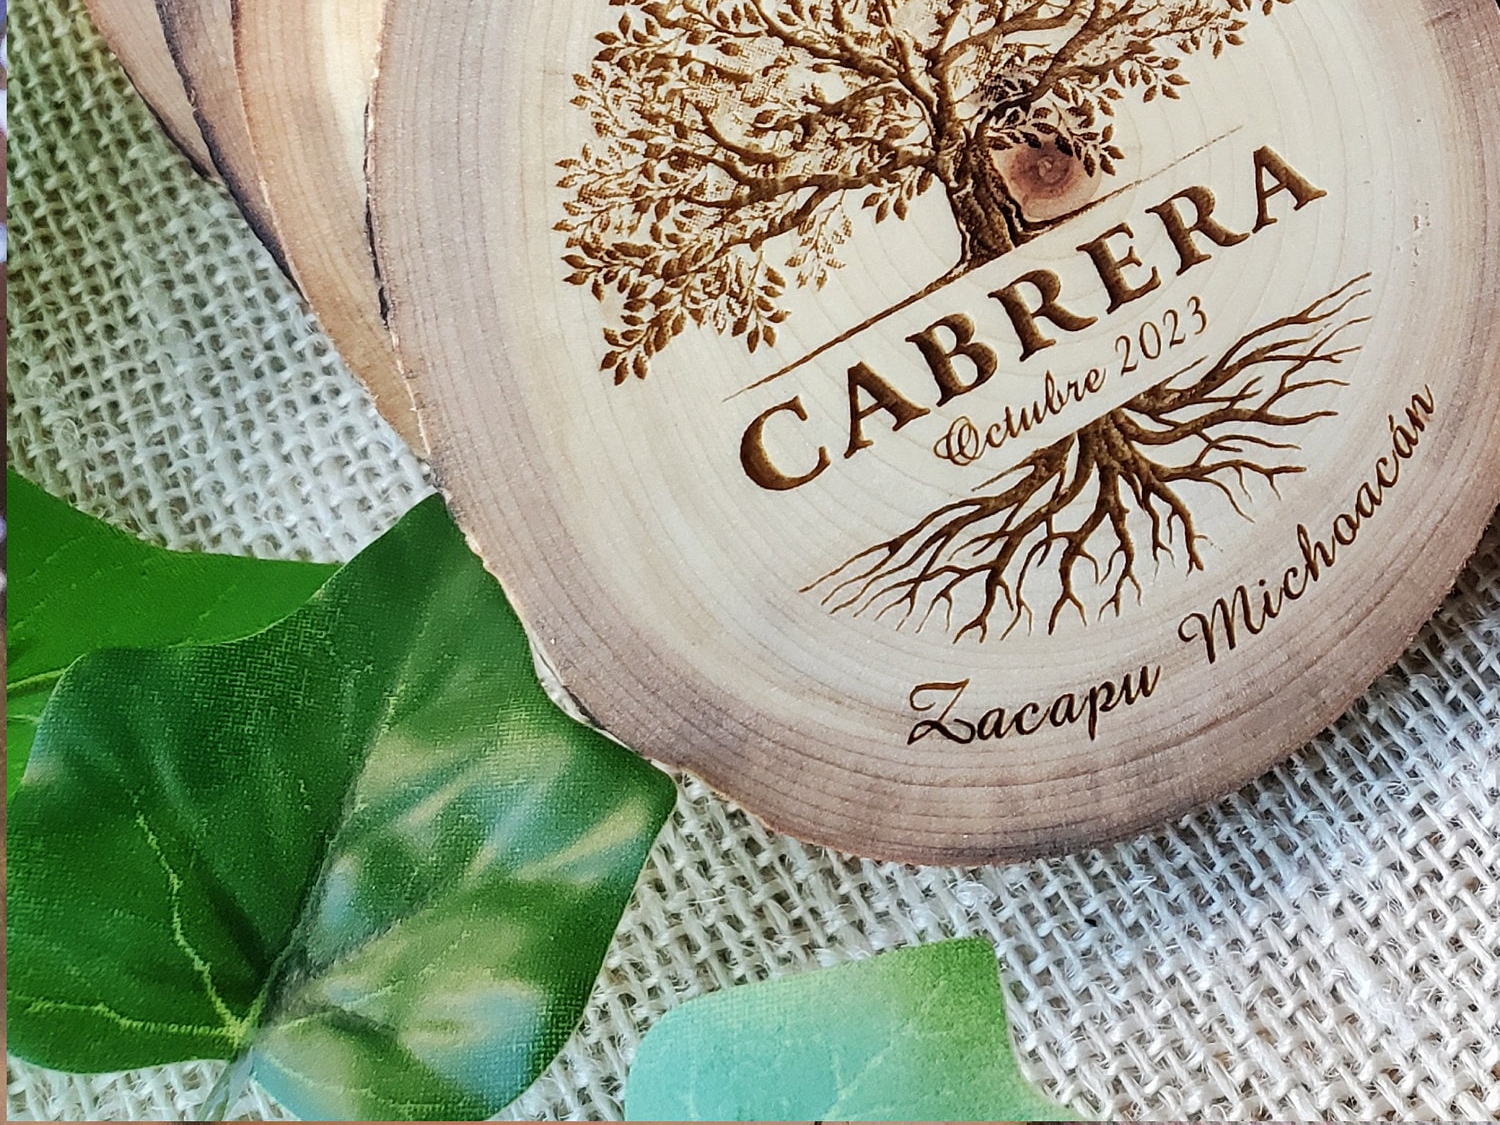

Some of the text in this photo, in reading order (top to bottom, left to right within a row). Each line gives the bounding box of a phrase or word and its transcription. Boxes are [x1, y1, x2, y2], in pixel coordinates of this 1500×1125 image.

[739, 145, 1327, 491] CABRERA
[933, 295, 1208, 467] Octubre 2023
[907, 382, 1435, 745] Zacapu Michoacán
